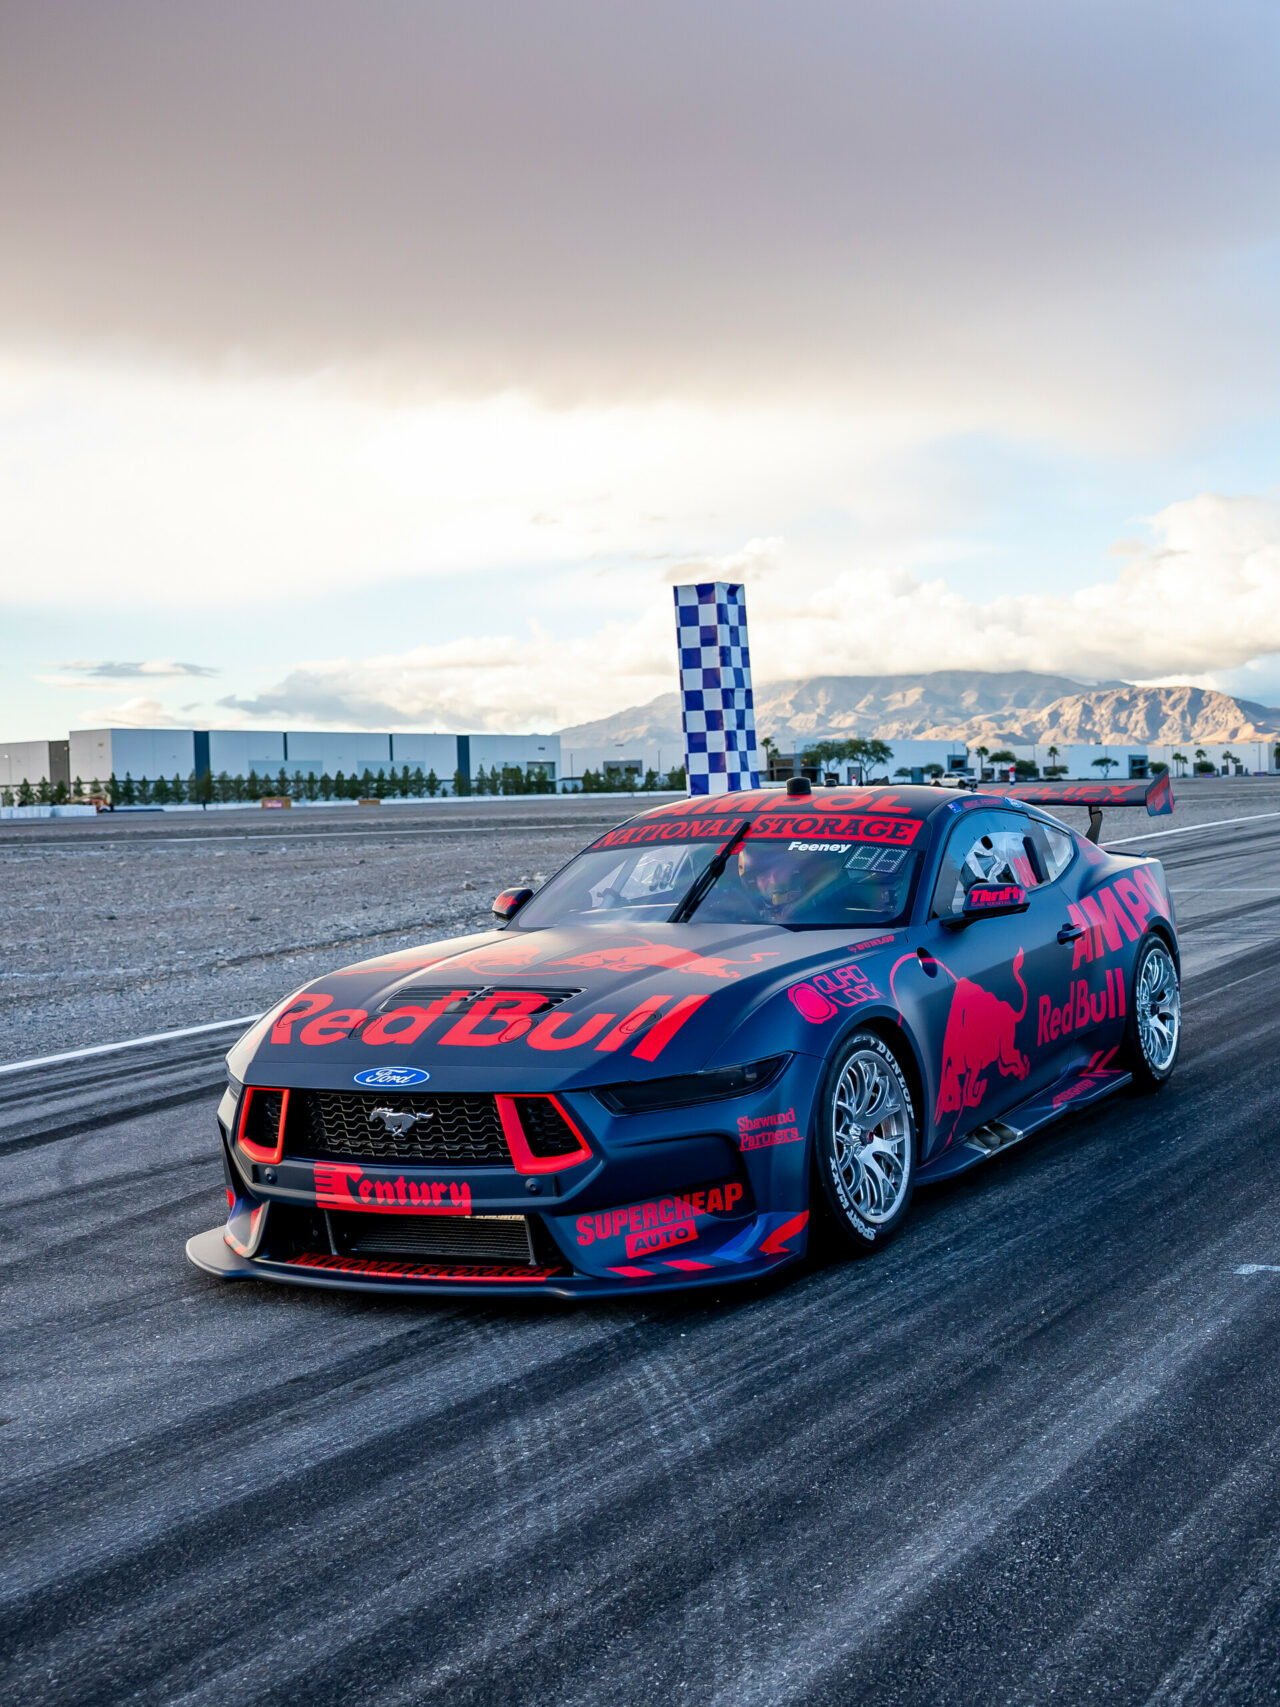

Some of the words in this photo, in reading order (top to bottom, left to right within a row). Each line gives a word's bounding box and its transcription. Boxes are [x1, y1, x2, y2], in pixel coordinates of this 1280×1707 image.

[644, 794, 912, 820] AMPOL
[592, 818, 745, 849] NATIONAL
[752, 817, 914, 840] STORAGE
[788, 841, 852, 854] Feeney
[1013, 855, 1037, 888] 88
[970, 886, 1026, 904] Thrifty
[856, 935, 895, 951] DUNLOP
[812, 965, 869, 994] QUAD
[829, 982, 887, 1007] LOCK
[1037, 981, 1075, 1047] Red
[1076, 968, 1126, 1029] Bull
[270, 990, 471, 1046] Red
[436, 990, 711, 1062] Bull
[366, 1068, 417, 1084] Ford
[739, 1127, 799, 1151] Partners
[314, 1161, 472, 1216] Century
[576, 1182, 743, 1246] SUPERCHEAP
[633, 1226, 689, 1253] AUTO
